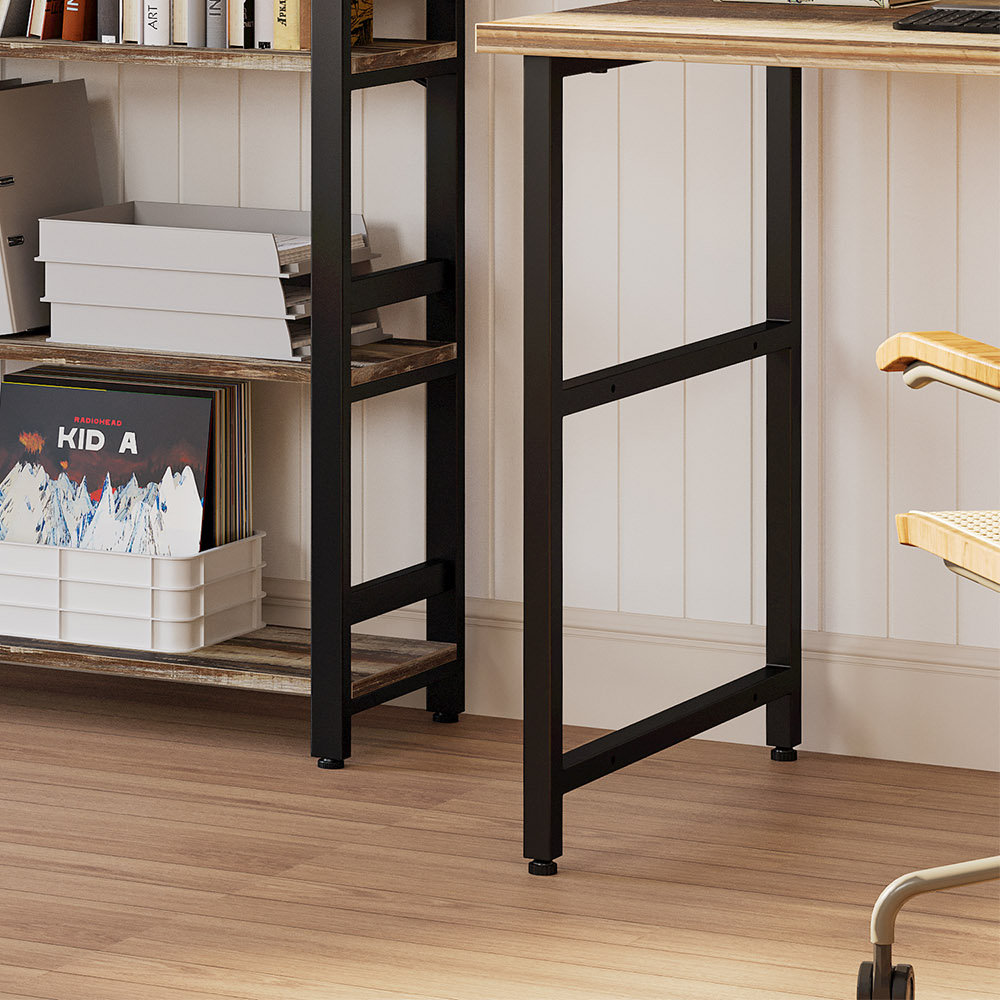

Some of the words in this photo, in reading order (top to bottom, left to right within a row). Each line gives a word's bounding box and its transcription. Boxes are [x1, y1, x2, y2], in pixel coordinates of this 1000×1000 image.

[147, 5, 158, 30] ART
[74, 416, 122, 427] RADIOHEAD
[57, 425, 106, 453] KID
[118, 431, 138, 455] A
